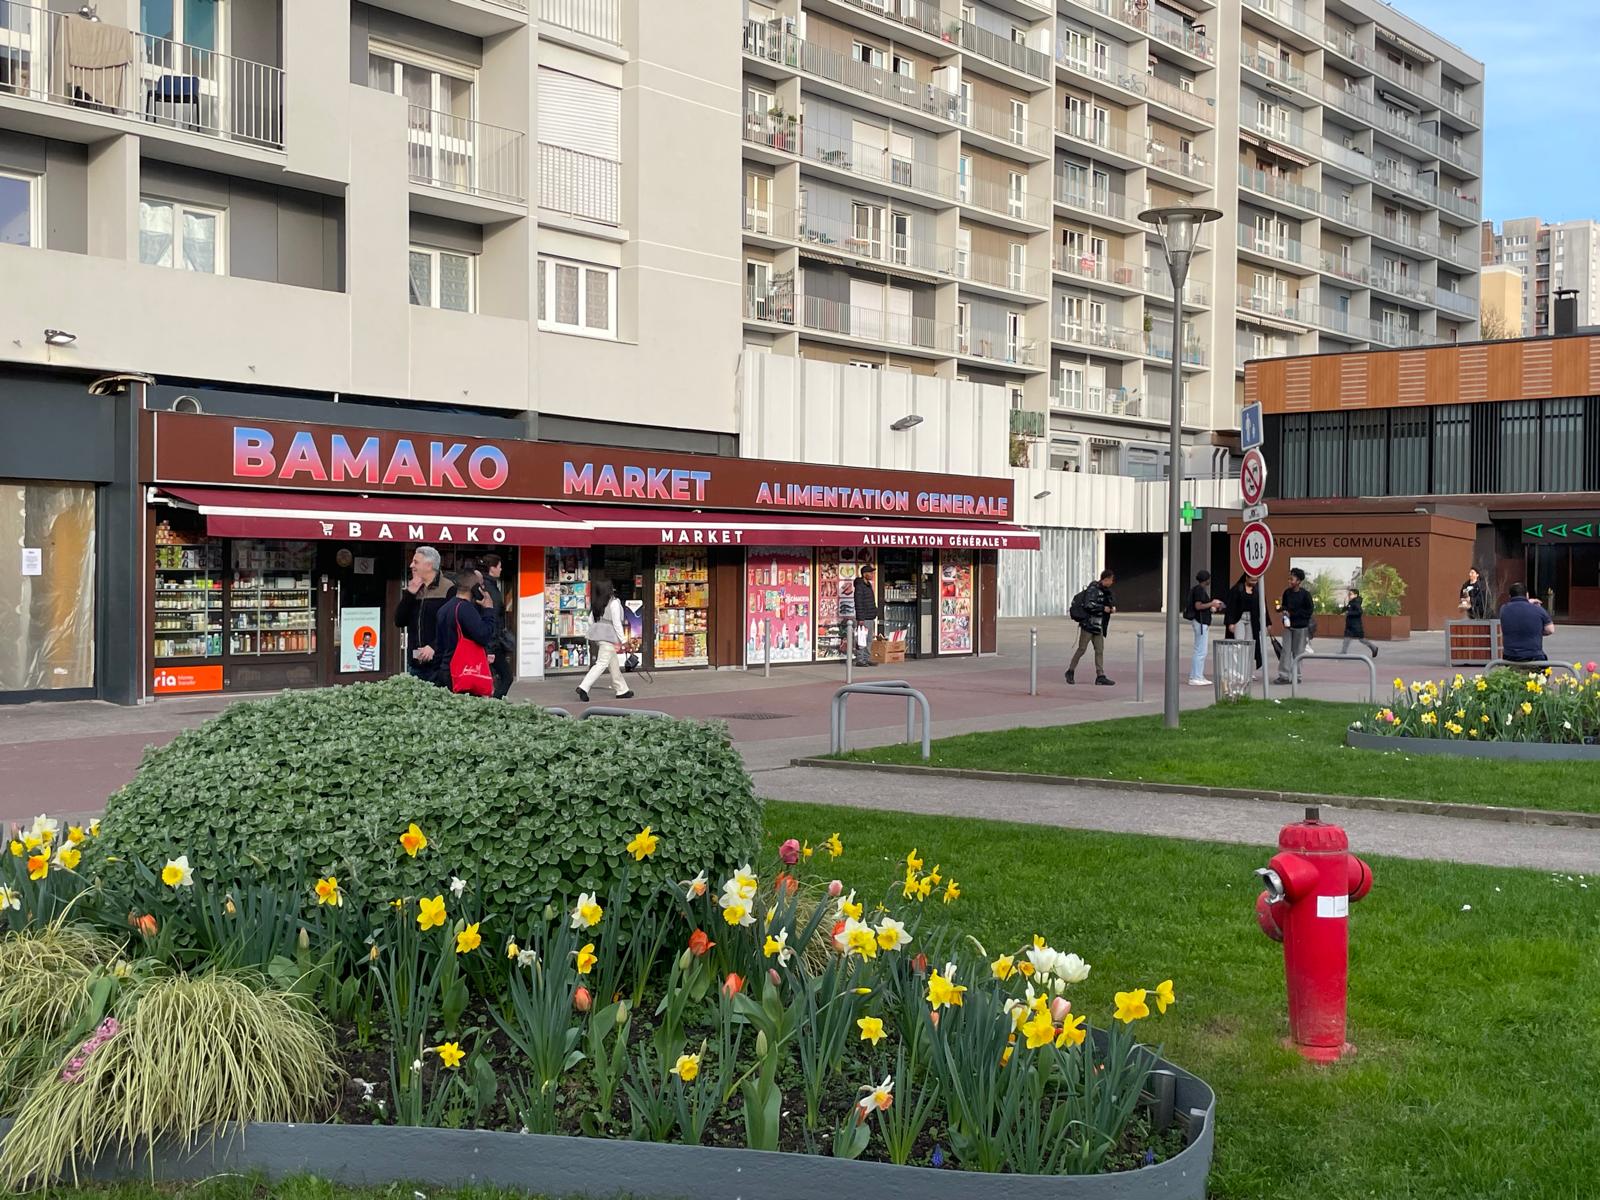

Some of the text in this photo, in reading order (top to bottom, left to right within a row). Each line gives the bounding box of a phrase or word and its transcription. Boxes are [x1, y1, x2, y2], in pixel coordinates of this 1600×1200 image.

[233, 426, 712, 502] BAMAKO MARKET
[756, 482, 1009, 516] ALIMENTATION GENERALE
[349, 522, 506, 543] BAMAKO
[661, 529, 744, 543] MARKET
[863, 534, 1000, 547] ALIMENTATION GÉNÉRALE
[1332, 537, 1421, 548] COMMUNALES
[154, 670, 177, 688] ria
